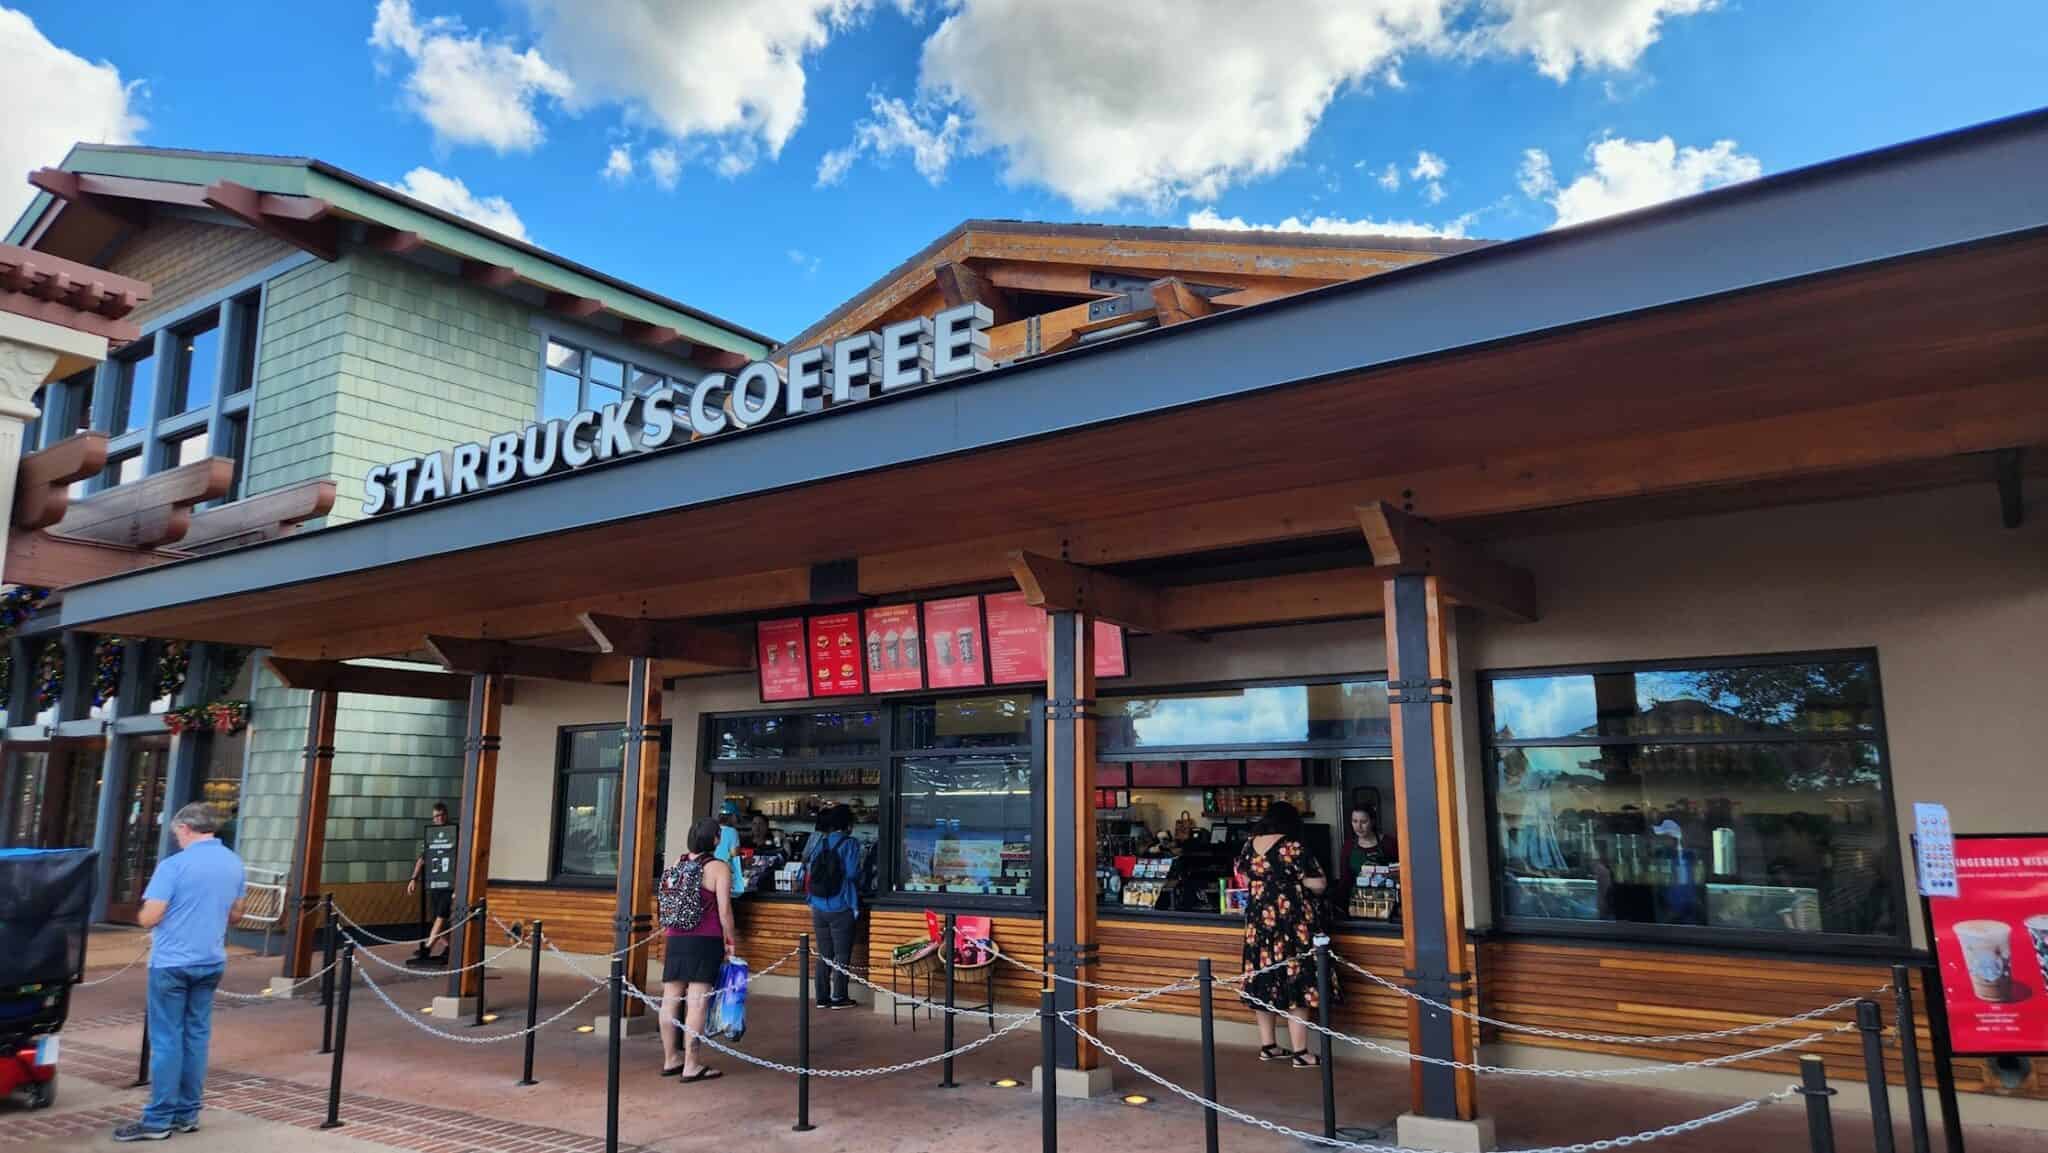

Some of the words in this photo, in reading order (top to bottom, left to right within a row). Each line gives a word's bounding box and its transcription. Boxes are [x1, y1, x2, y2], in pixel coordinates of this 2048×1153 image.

[362, 388, 675, 514] STARBUCKS
[689, 302, 982, 435] COFFEE
[1955, 857, 2020, 868] INGERBREAD
